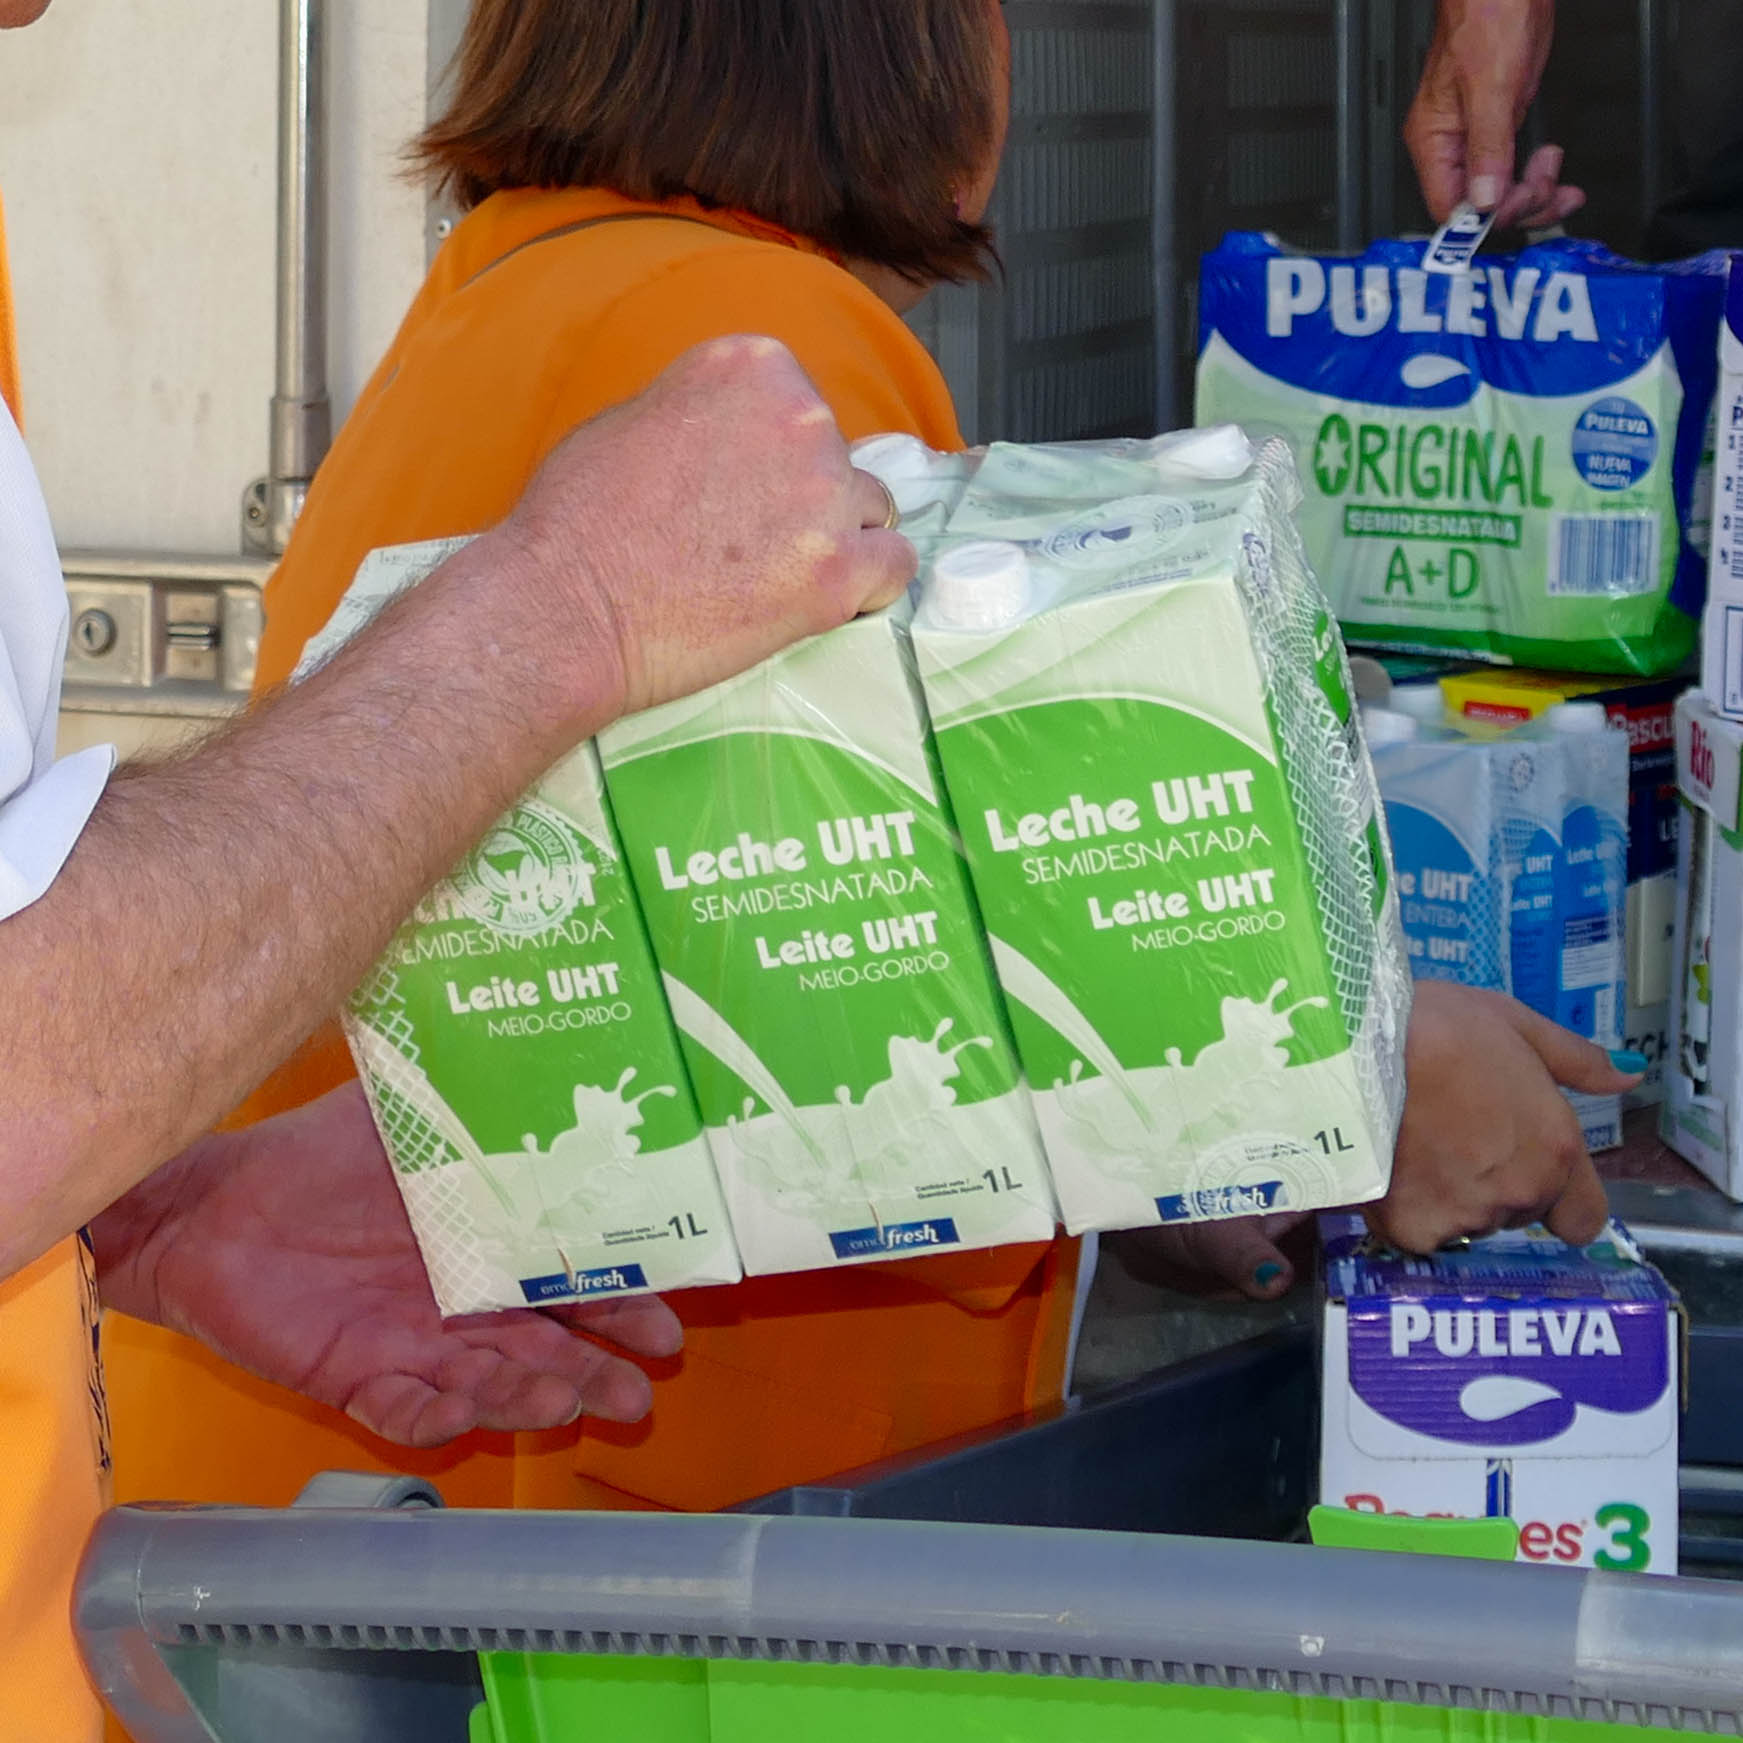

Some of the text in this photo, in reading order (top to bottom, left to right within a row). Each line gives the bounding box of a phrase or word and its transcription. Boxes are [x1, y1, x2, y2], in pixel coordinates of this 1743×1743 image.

[1266, 257, 1600, 342] PULEVA
[1586, 412, 1649, 435] PULEVA
[1313, 412, 1554, 508] ORIGINAL
[985, 770, 1255, 856] Leche UHT
[655, 811, 917, 893] Leche UHT
[1021, 823, 1272, 886] SEMIDESNATADA
[690, 866, 934, 925] SEMIDESNATADA
[1087, 868, 1277, 933] Leite UHT
[1421, 869, 1472, 903] UHT
[401, 917, 616, 965] EMIDESNATADA
[756, 911, 939, 971] Leite UHT
[1131, 908, 1287, 955] MEIO-GORDO
[1429, 936, 1469, 963] UHT
[446, 962, 620, 1015] Leite UHT
[798, 948, 951, 993] MEIO-GORDO
[487, 1001, 632, 1039] MEIO-GORDO
[1313, 1126, 1355, 1156] 1L
[982, 1165, 1023, 1194] 1L
[668, 1212, 708, 1242] 1L
[1390, 1302, 1622, 1357] PULEVA
[1594, 1501, 1652, 1572] 3
